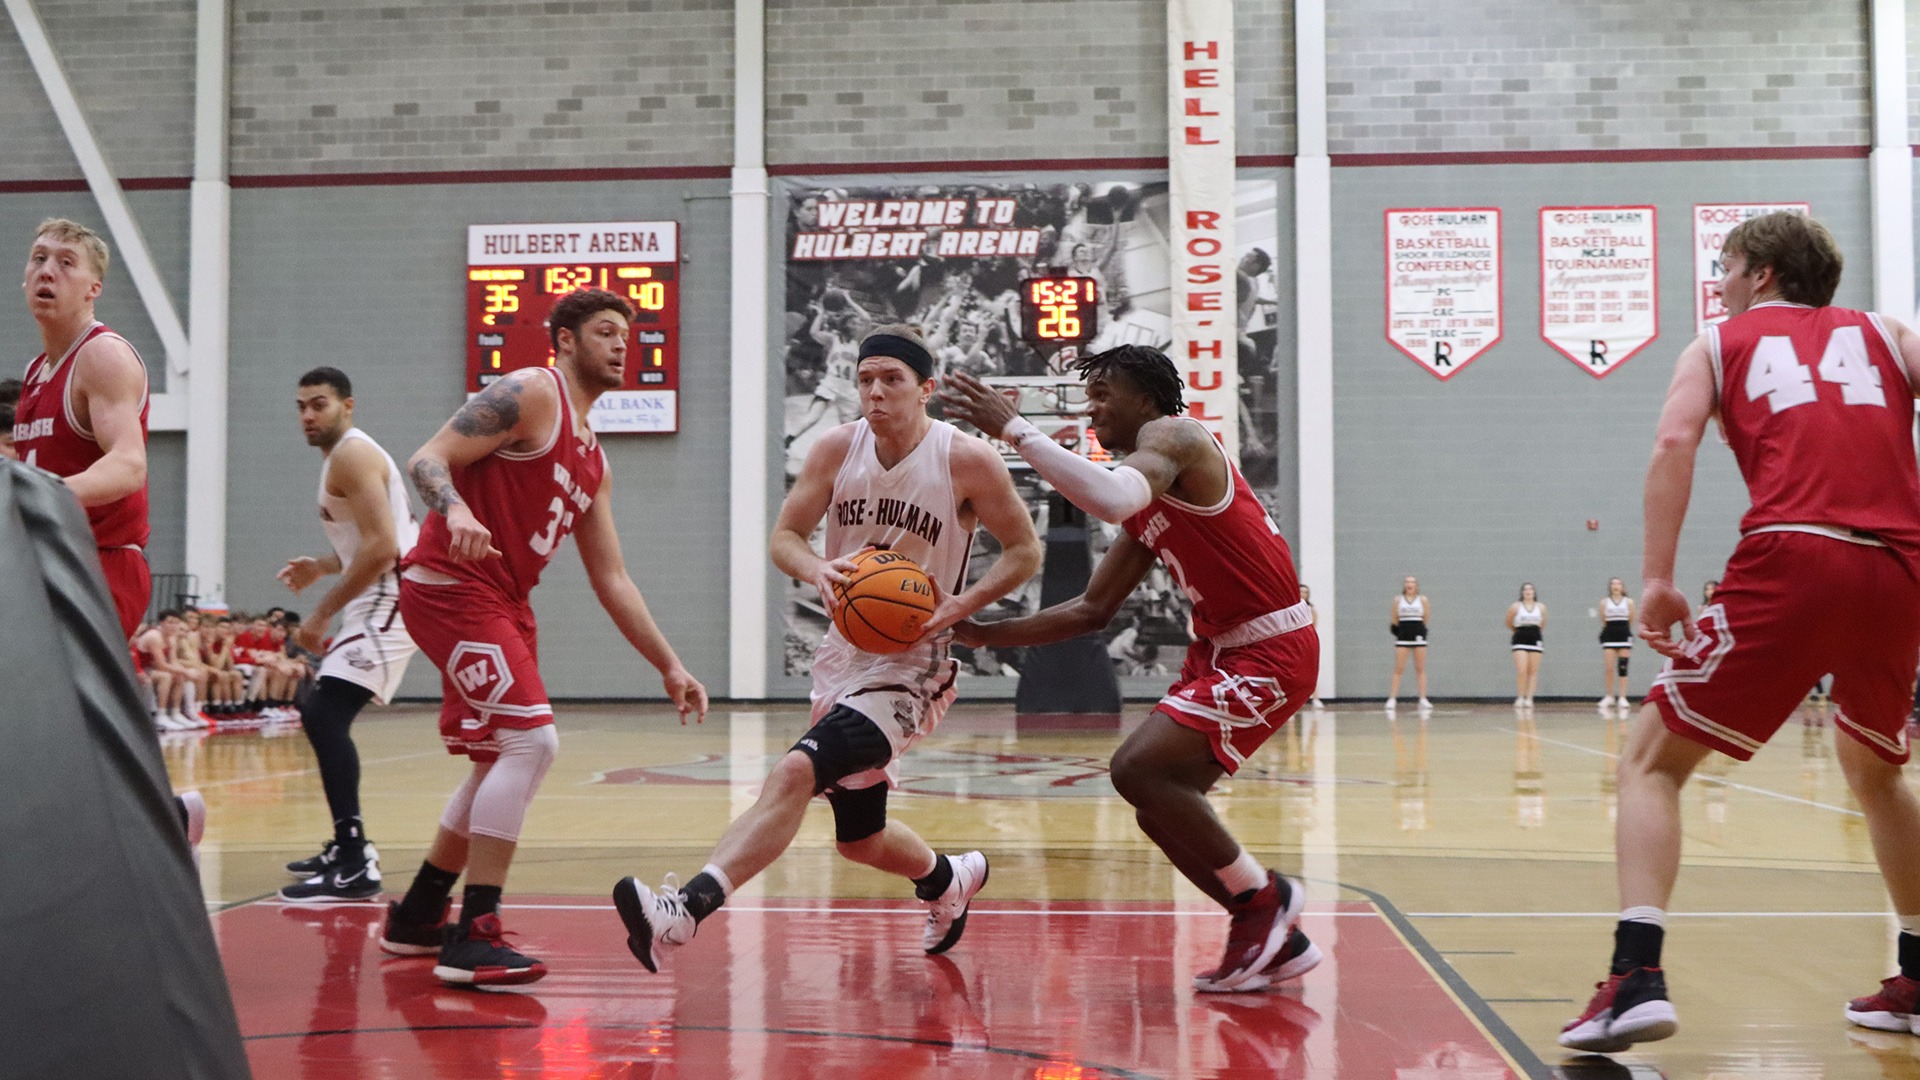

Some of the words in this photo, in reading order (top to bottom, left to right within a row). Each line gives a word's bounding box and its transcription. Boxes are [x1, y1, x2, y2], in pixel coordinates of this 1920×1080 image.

[1184, 40, 1220, 145] HELL
[818, 200, 967, 227] WELCOME
[975, 198, 1016, 224] TO
[484, 233, 581, 254] HULBERT
[588, 231, 660, 253] ARENA
[793, 231, 928, 260] HULBERT
[937, 228, 1041, 257] ARENA
[1395, 237, 1491, 249] BASKETBALL
[1550, 236, 1646, 248] BASKETBALL
[1582, 248, 1616, 257] NCAA
[1396, 260, 1492, 272] CONFERENCE
[1547, 258, 1651, 270] TOURNAMENT
[485, 285, 519, 312] 35
[629, 282, 664, 310] 40
[1032, 280, 1094, 305] 15:21
[1038, 305, 1081, 338] 26
[1432, 308, 1454, 316] CAC
[1186, 210, 1225, 448] ROSE-HUL
[491, 350, 501, 369] 1
[653, 347, 662, 366] 1
[1745, 325, 1888, 415] 44
[592, 398, 615, 410] AL
[621, 398, 665, 410] BANK
